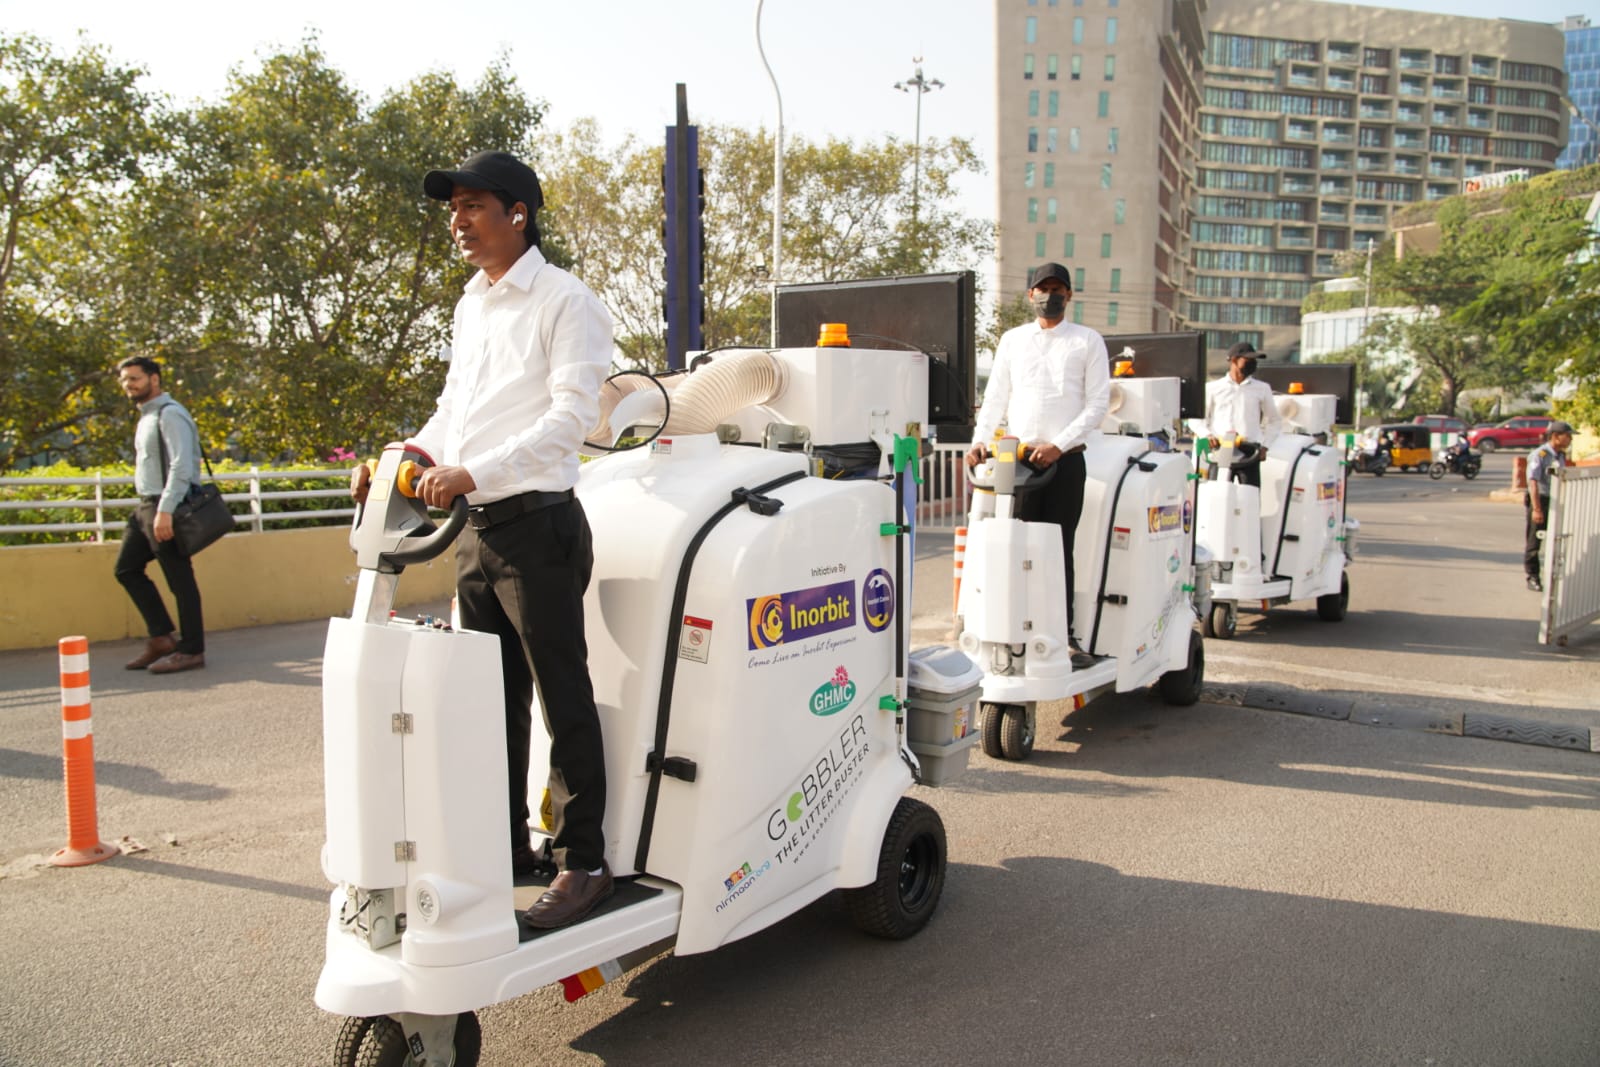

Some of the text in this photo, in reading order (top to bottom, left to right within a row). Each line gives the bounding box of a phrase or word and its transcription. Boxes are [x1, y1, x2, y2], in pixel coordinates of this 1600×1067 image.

[811, 563, 847, 577] Initiative By
[790, 594, 850, 630] Inorbit
[748, 656, 770, 669] Come
[772, 652, 789, 665] Live
[814, 684, 852, 711] GHMC
[775, 743, 870, 865] THE LITTER BUSTER
